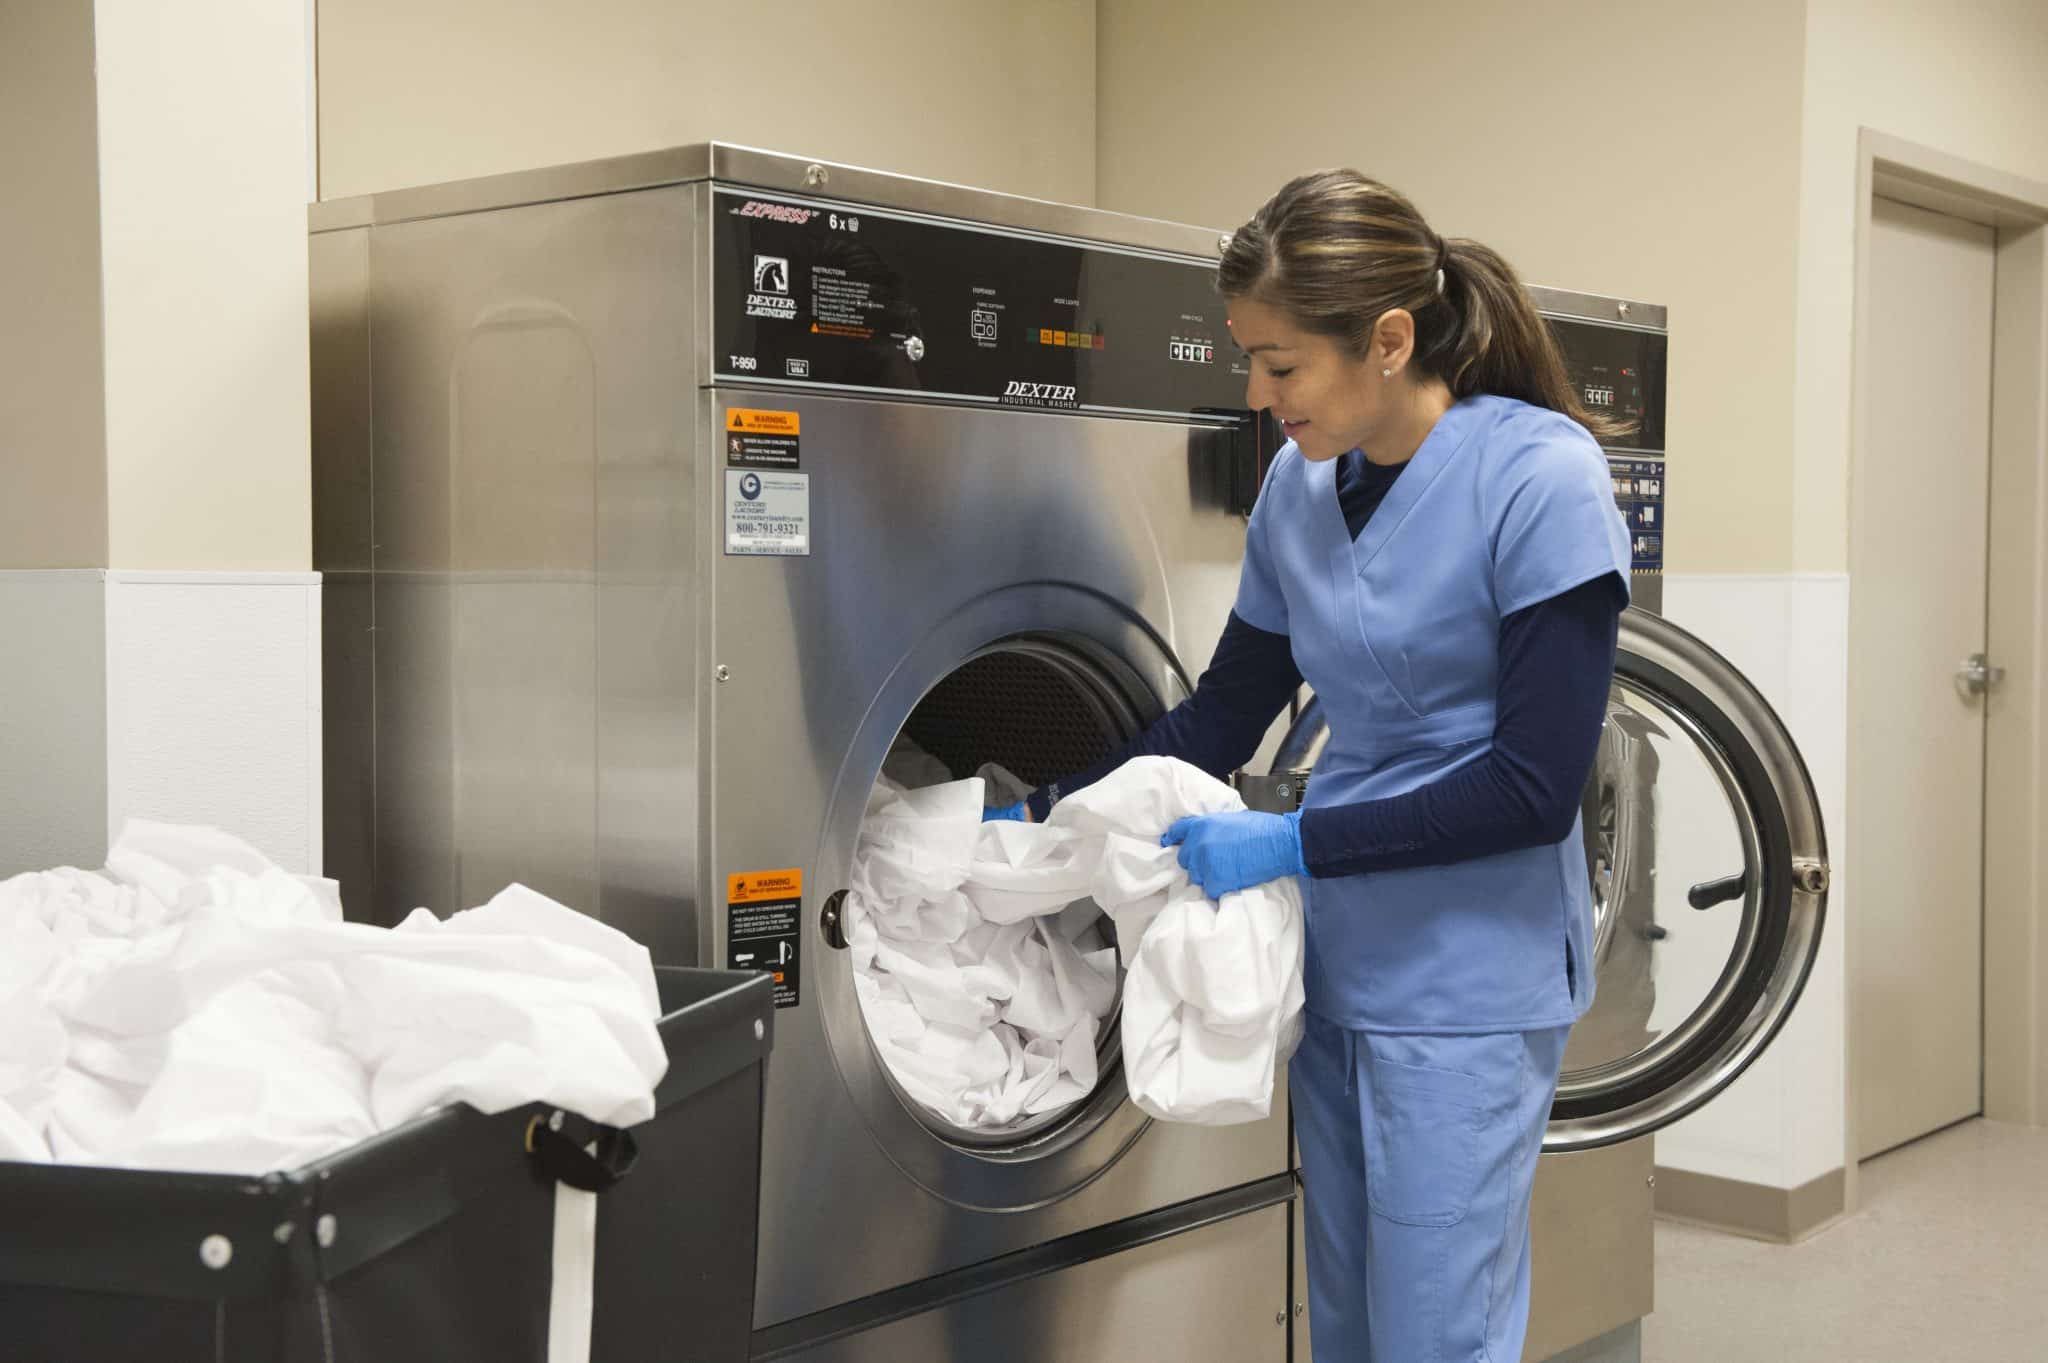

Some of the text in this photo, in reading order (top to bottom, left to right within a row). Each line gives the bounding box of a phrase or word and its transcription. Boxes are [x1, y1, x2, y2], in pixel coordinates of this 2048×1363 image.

[739, 200, 811, 225] EXPRESS
[829, 213, 838, 230] 6
[746, 293, 796, 310] DEXTER
[745, 305, 797, 320] LAUNDRY
[730, 355, 758, 371] T-950
[1003, 381, 1076, 401] DEXTER
[1001, 395, 1078, 409] INDUSTRIAL WASHER
[753, 415, 788, 425] WARNING
[736, 522, 799, 535] 800-791-9321
[757, 878, 791, 888] WARNING
